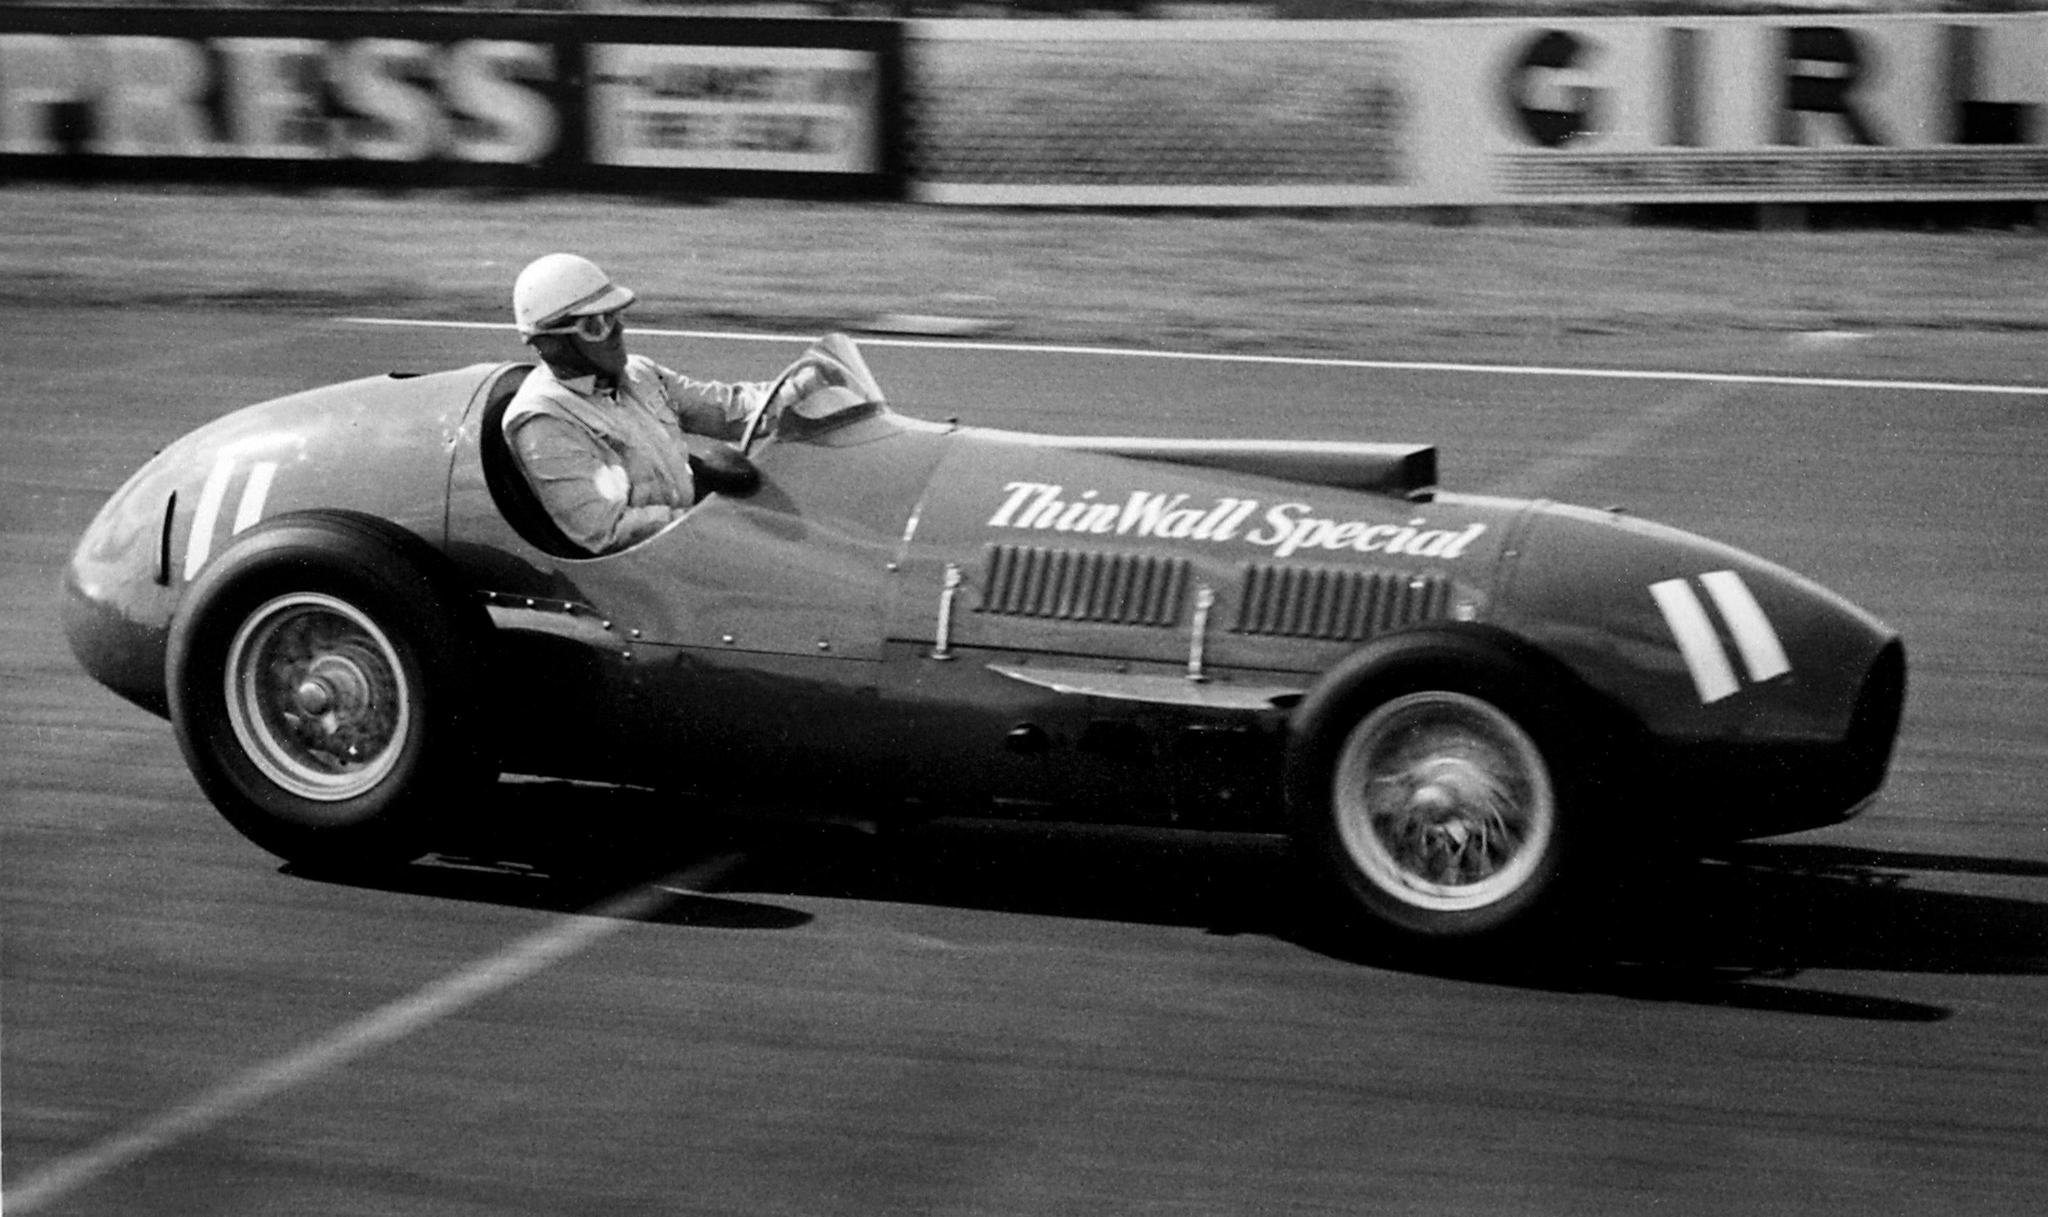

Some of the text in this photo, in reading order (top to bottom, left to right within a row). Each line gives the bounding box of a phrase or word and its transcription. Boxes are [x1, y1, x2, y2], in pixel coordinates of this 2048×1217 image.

[1496, 25, 2044, 149] GIRL
[1245, 501, 1487, 559] Special
[1648, 570, 1792, 704] 11
